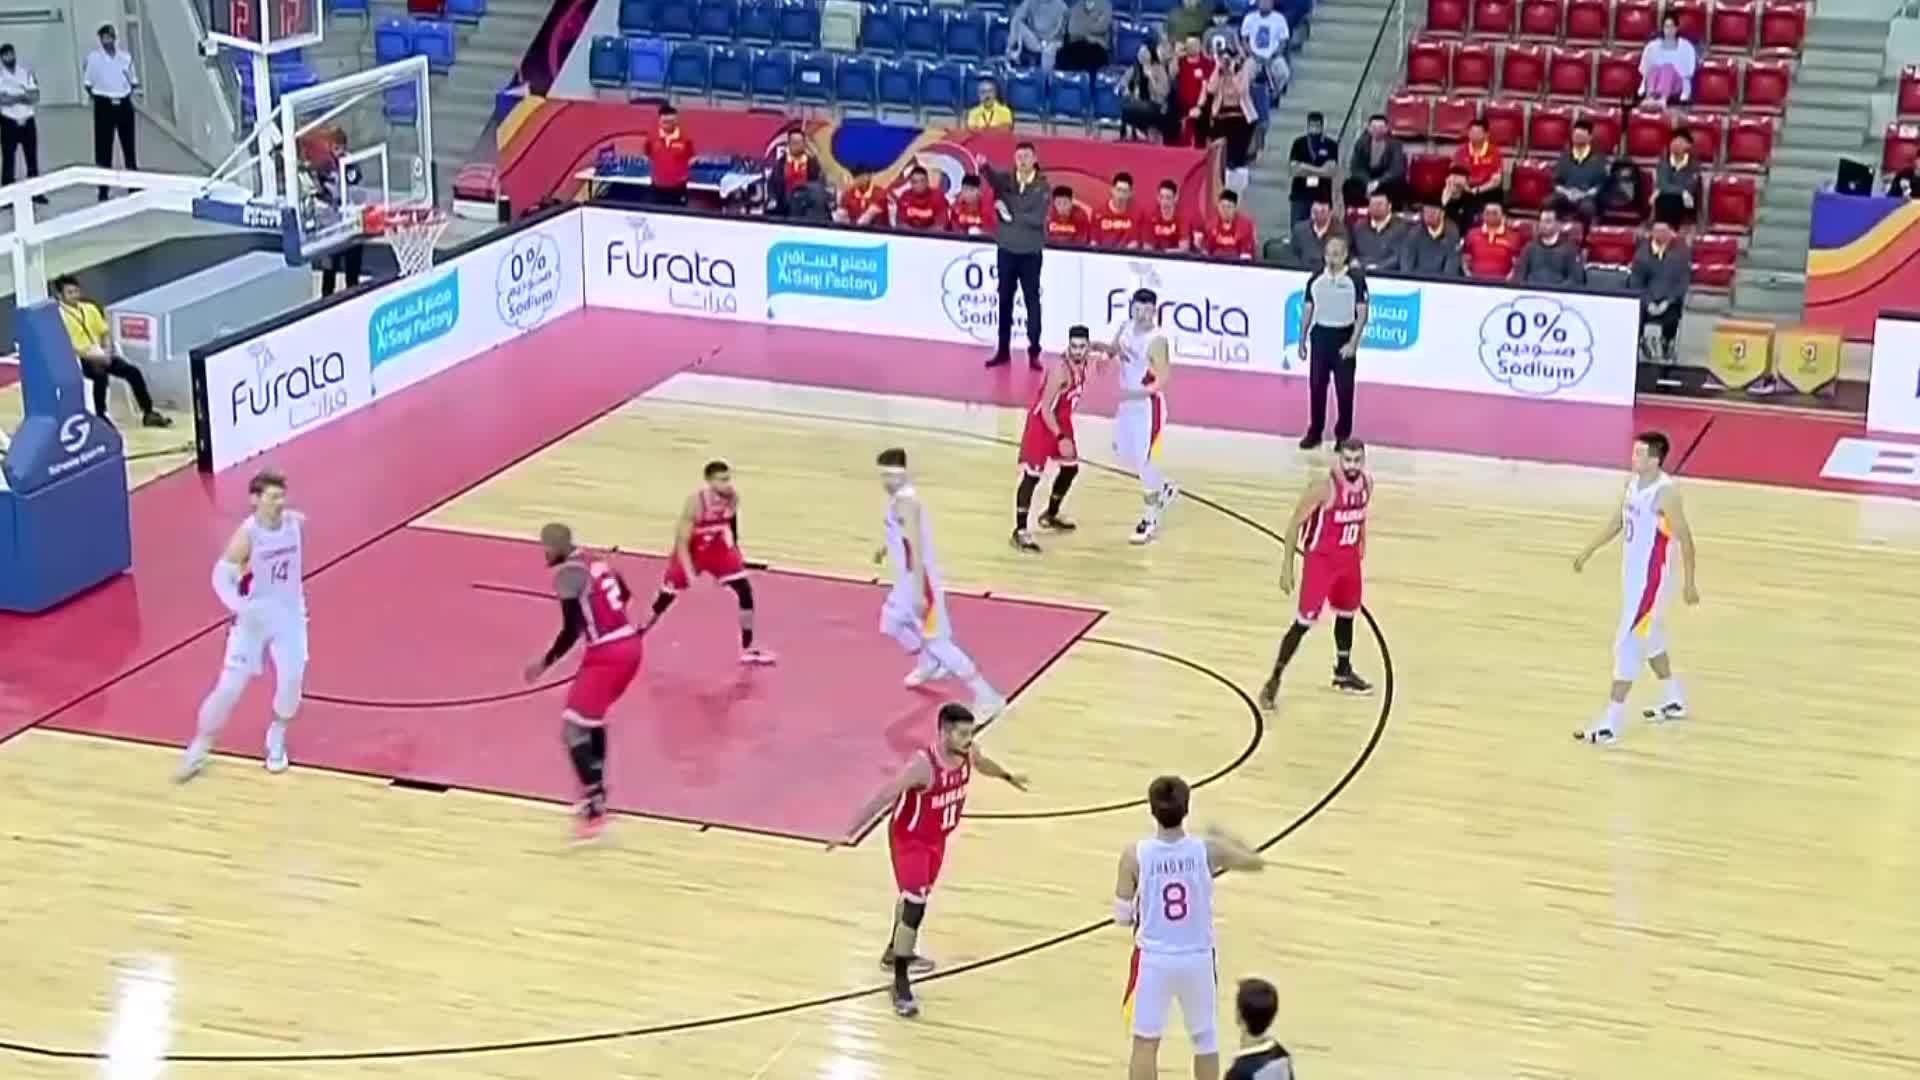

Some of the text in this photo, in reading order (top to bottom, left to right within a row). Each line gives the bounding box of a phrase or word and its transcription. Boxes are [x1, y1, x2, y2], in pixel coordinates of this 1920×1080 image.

[511, 240, 547, 283] 0%
[607, 240, 735, 289] Furata
[509, 289, 553, 319] Sodium
[959, 309, 1000, 326] Sodi
[1107, 288, 1249, 337] Frata
[1505, 311, 1567, 342] 0%
[1498, 360, 1575, 379] Sodium
[231, 351, 345, 427] Furata
[1338, 523, 1360, 546] 10
[270, 559, 291, 585] 14
[600, 577, 623, 611] 2
[940, 803, 958, 832] 11
[1162, 882, 1188, 921] 8
